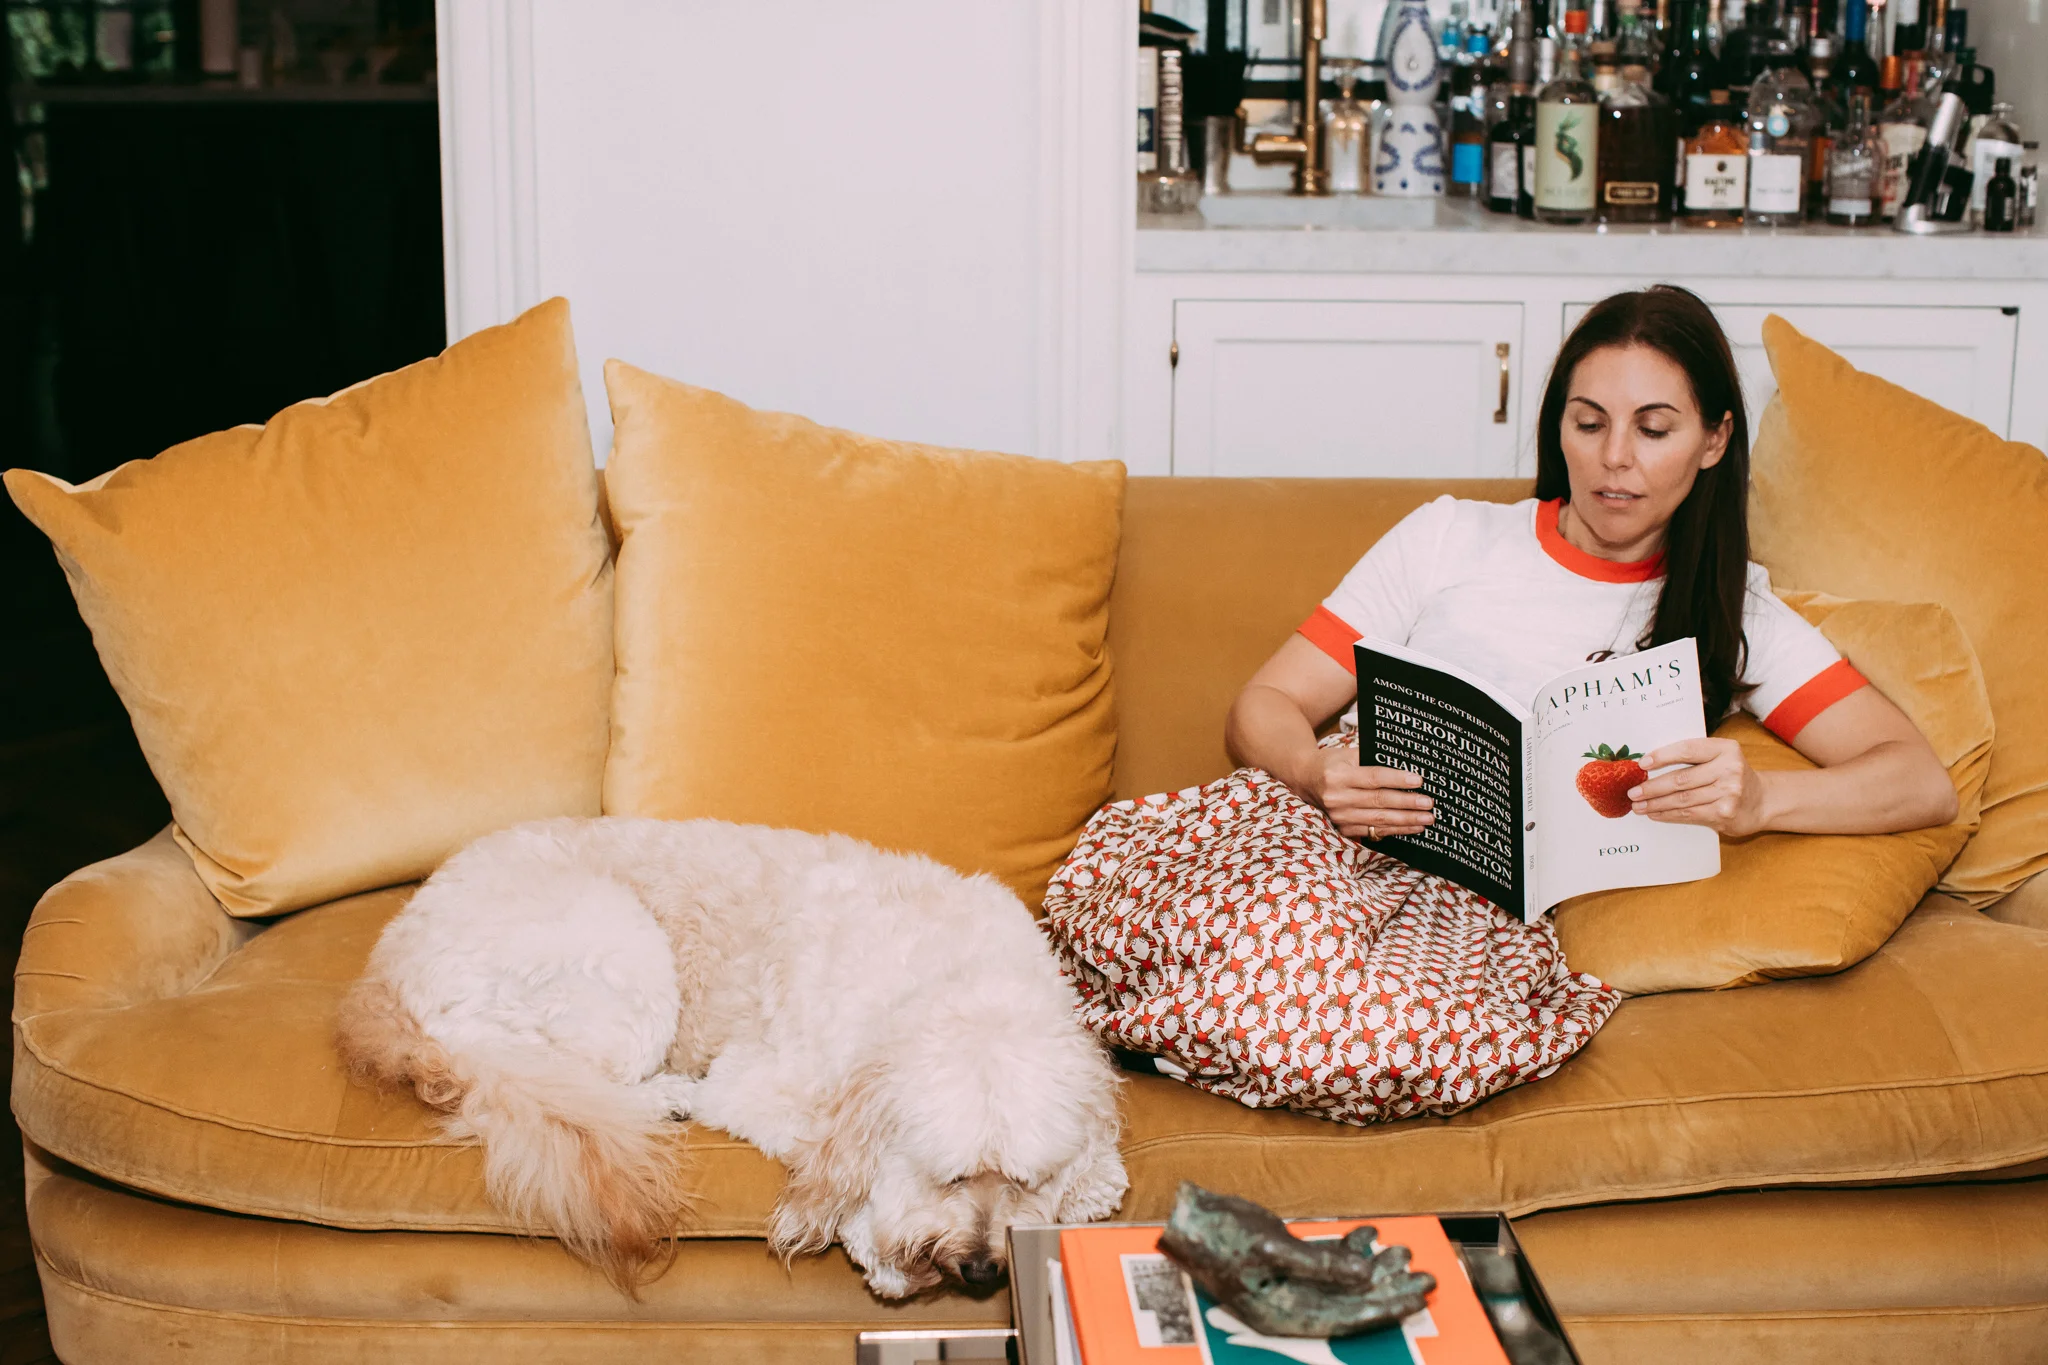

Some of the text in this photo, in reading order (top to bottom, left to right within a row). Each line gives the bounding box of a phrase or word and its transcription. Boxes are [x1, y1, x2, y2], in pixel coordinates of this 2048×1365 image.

[1373, 677, 1510, 746] AMONG THE CONTRIBUTORS
[1536, 682, 1682, 739] QUARTERLY
[1537, 659, 1681, 725] LAPHAM'S
[1374, 694, 1510, 762] CHARLES BAUDELAIRE HARPER LEE
[1374, 704, 1458, 746] EMPEROR
[1458, 736, 1510, 777] JULIAN
[1375, 719, 1510, 786] PLUTARCH ALEXANDRE DUMAS
[1375, 729, 1510, 798] HUNTER S. THOMPSON
[1375, 741, 1511, 809] TOBIAS SMOLLETT PETRONIUS
[1375, 752, 1512, 823] CHARLES DICKENS
[1526, 772, 1534, 812] QUARTERLY
[1422, 782, 1511, 835] HILD FERDOWSI
[1443, 801, 1512, 845] WALTER BENJAMIN
[1448, 813, 1512, 858] TOKLAS
[1410, 837, 1444, 854] MASON
[1448, 851, 1489, 878] DEBORAH
[1489, 872, 1512, 891] BLUM
[1424, 828, 1512, 881] ELLINGTON
[1468, 837, 1512, 868] XENOPHON
[1599, 845, 1640, 857] FOOD
